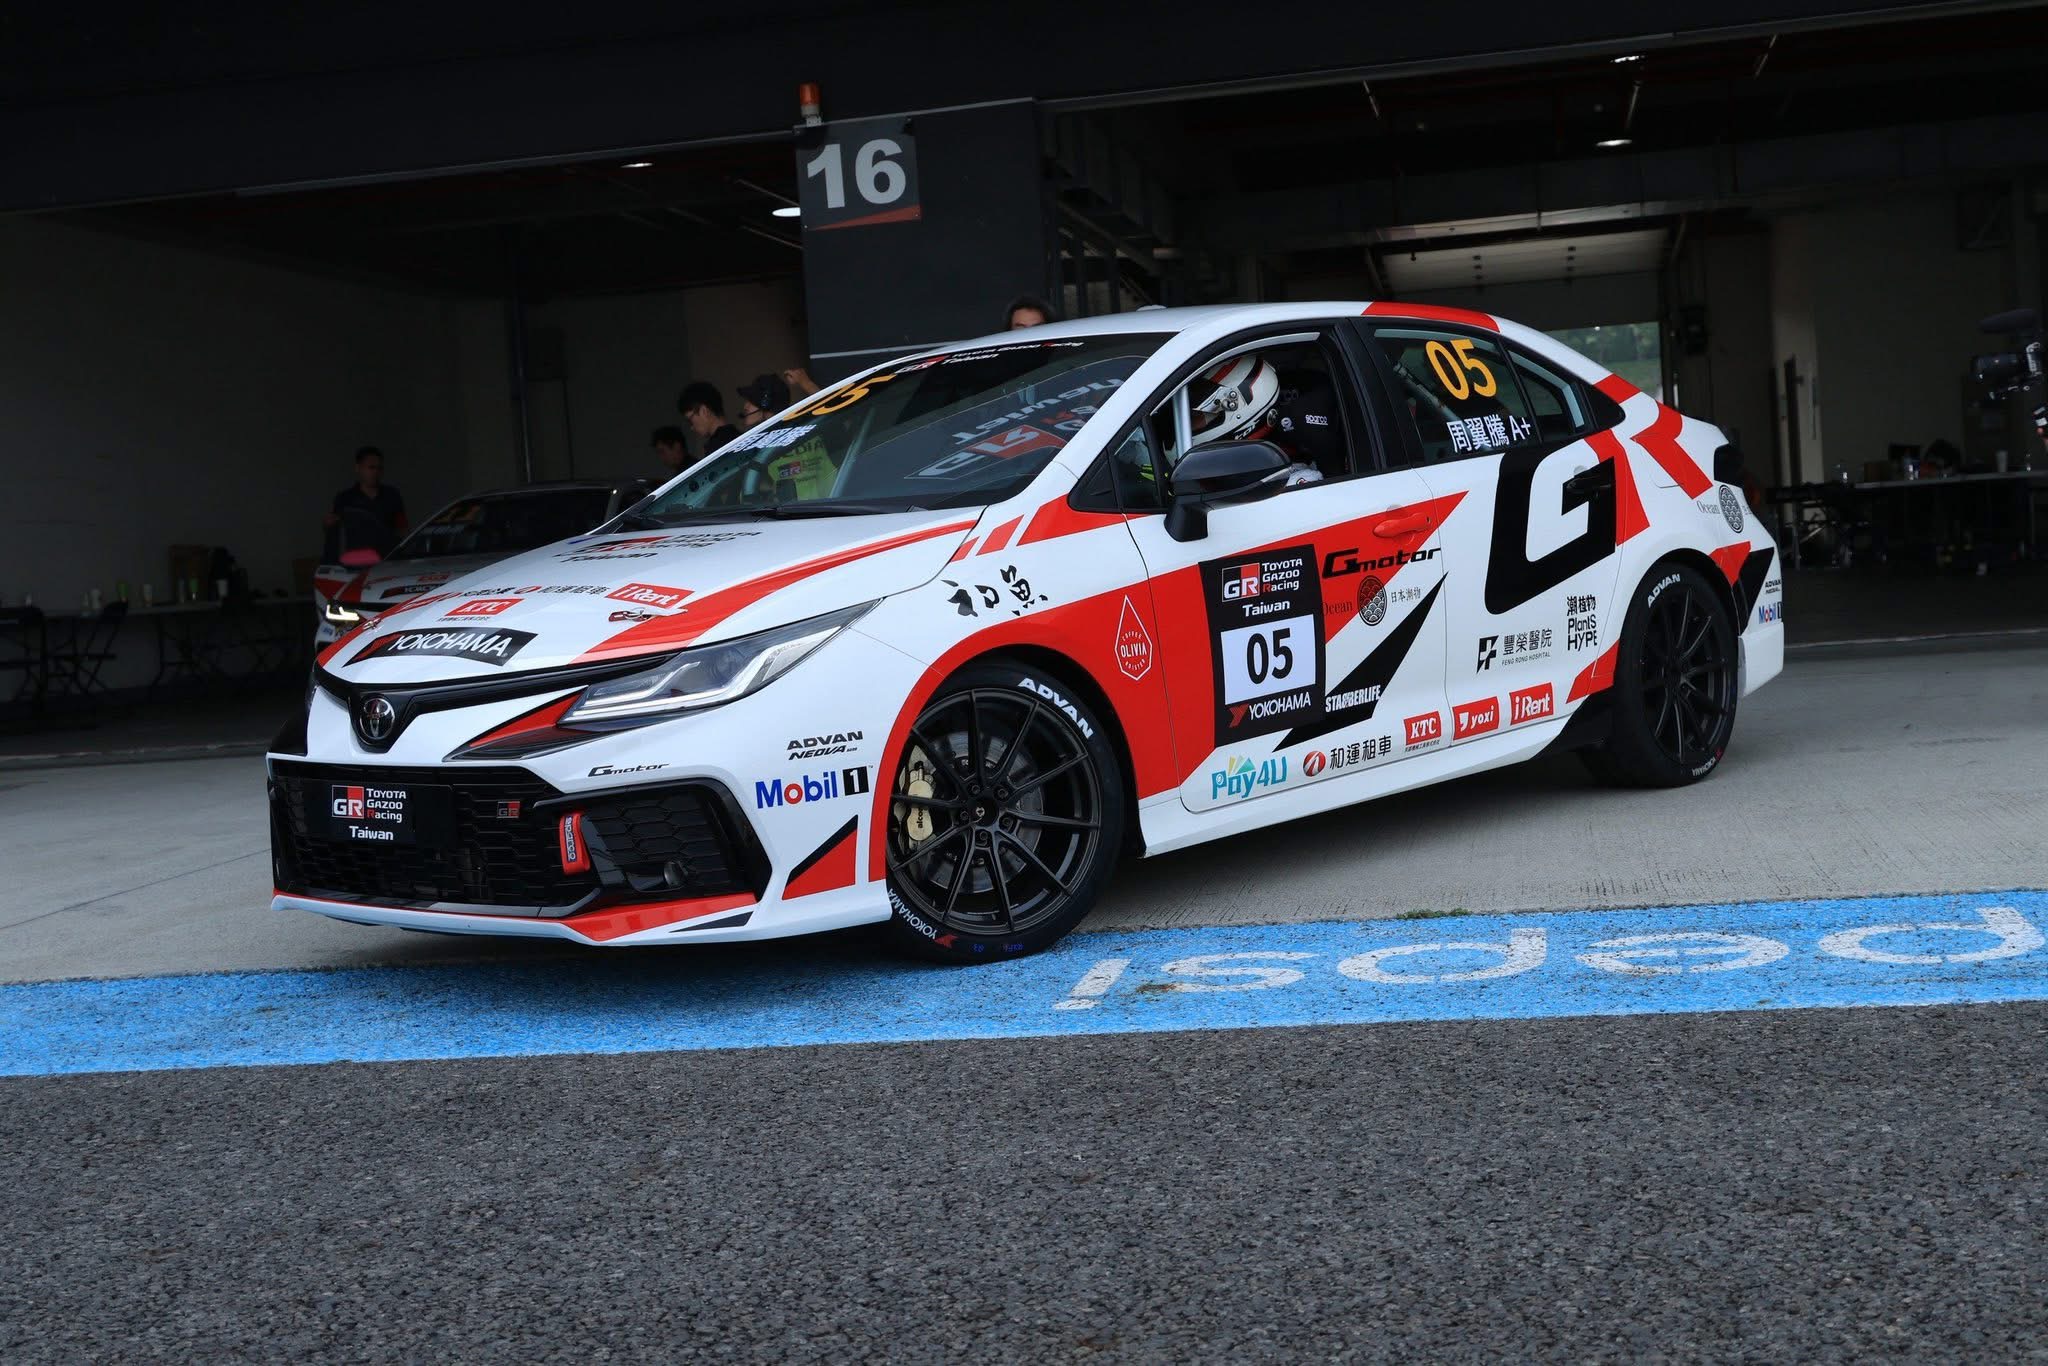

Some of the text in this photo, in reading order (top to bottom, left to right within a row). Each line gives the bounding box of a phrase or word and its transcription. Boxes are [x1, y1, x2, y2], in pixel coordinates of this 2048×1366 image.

[807, 139, 907, 209] 16
[1426, 338, 1497, 400] 05
[1305, 414, 1328, 426] sparco
[1509, 415, 1531, 441] A+
[1262, 558, 1303, 572] TOYOTA
[1321, 547, 1442, 579] Gmotor
[1262, 569, 1300, 583] GAZOO
[1263, 580, 1300, 593] Racing
[615, 585, 680, 605] iRent
[1224, 576, 1259, 599] GR
[1648, 573, 1681, 609] ADVAN
[458, 601, 511, 613] KTC
[1242, 600, 1291, 617] Taiwan
[1567, 594, 1597, 616] 潮植物
[1759, 602, 1777, 624] Mobil
[388, 632, 513, 657] YOKOHAMA
[1120, 642, 1147, 658] OLIVIA
[1503, 628, 1552, 655] 豐榮醫院
[1567, 631, 1598, 651] HYPE
[1247, 627, 1293, 685] 05
[1018, 677, 1093, 739] ADVAN
[1249, 691, 1311, 720] YOKOHAMA
[1411, 717, 1437, 739] KTC
[1471, 706, 1494, 729] yoxi
[787, 731, 863, 750] ADVAN
[788, 745, 847, 760] NEOVA
[1330, 735, 1392, 769] 和運租車
[588, 763, 669, 777] Gmotor
[366, 788, 407, 799] TOYOTA
[755, 771, 838, 809] Mobil
[333, 798, 363, 817] GR
[366, 799, 403, 810] GAZOO
[367, 809, 403, 823] Racing
[916, 808, 924, 829] alco
[349, 825, 394, 840] Taiwan
[565, 816, 577, 861] sparco
[888, 888, 938, 940] YOKOHAMA
[1053, 906, 2045, 1011] pepsi
